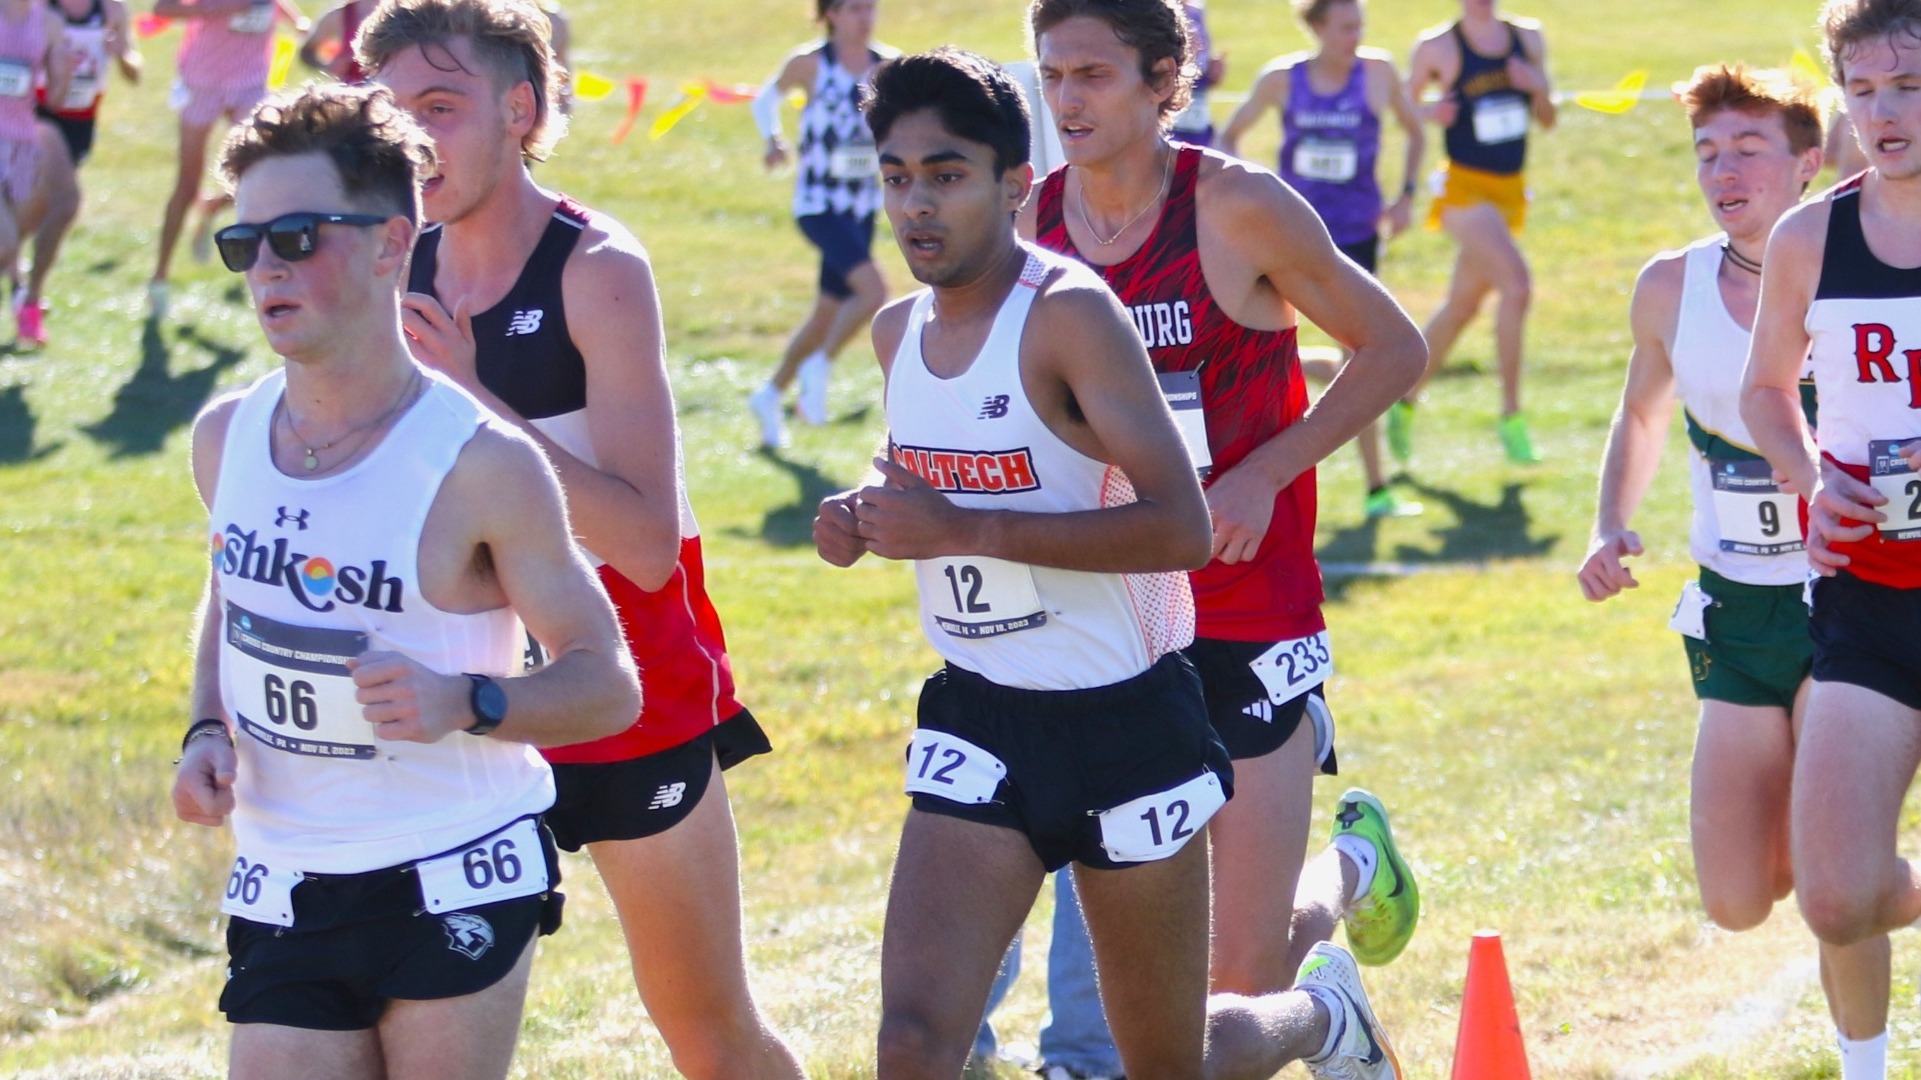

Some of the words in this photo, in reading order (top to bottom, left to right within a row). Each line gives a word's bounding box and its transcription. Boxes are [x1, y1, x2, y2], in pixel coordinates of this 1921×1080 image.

[1126, 300, 1193, 348] URG
[1758, 500, 1780, 538] 9
[944, 564, 991, 614] 12
[979, 625, 994, 635] NOV
[1275, 634, 1330, 687] 233
[264, 673, 318, 731] 66
[916, 742, 967, 785] 12
[1140, 800, 1194, 846] 12
[227, 856, 270, 905] 66
[462, 838, 523, 890] 66
